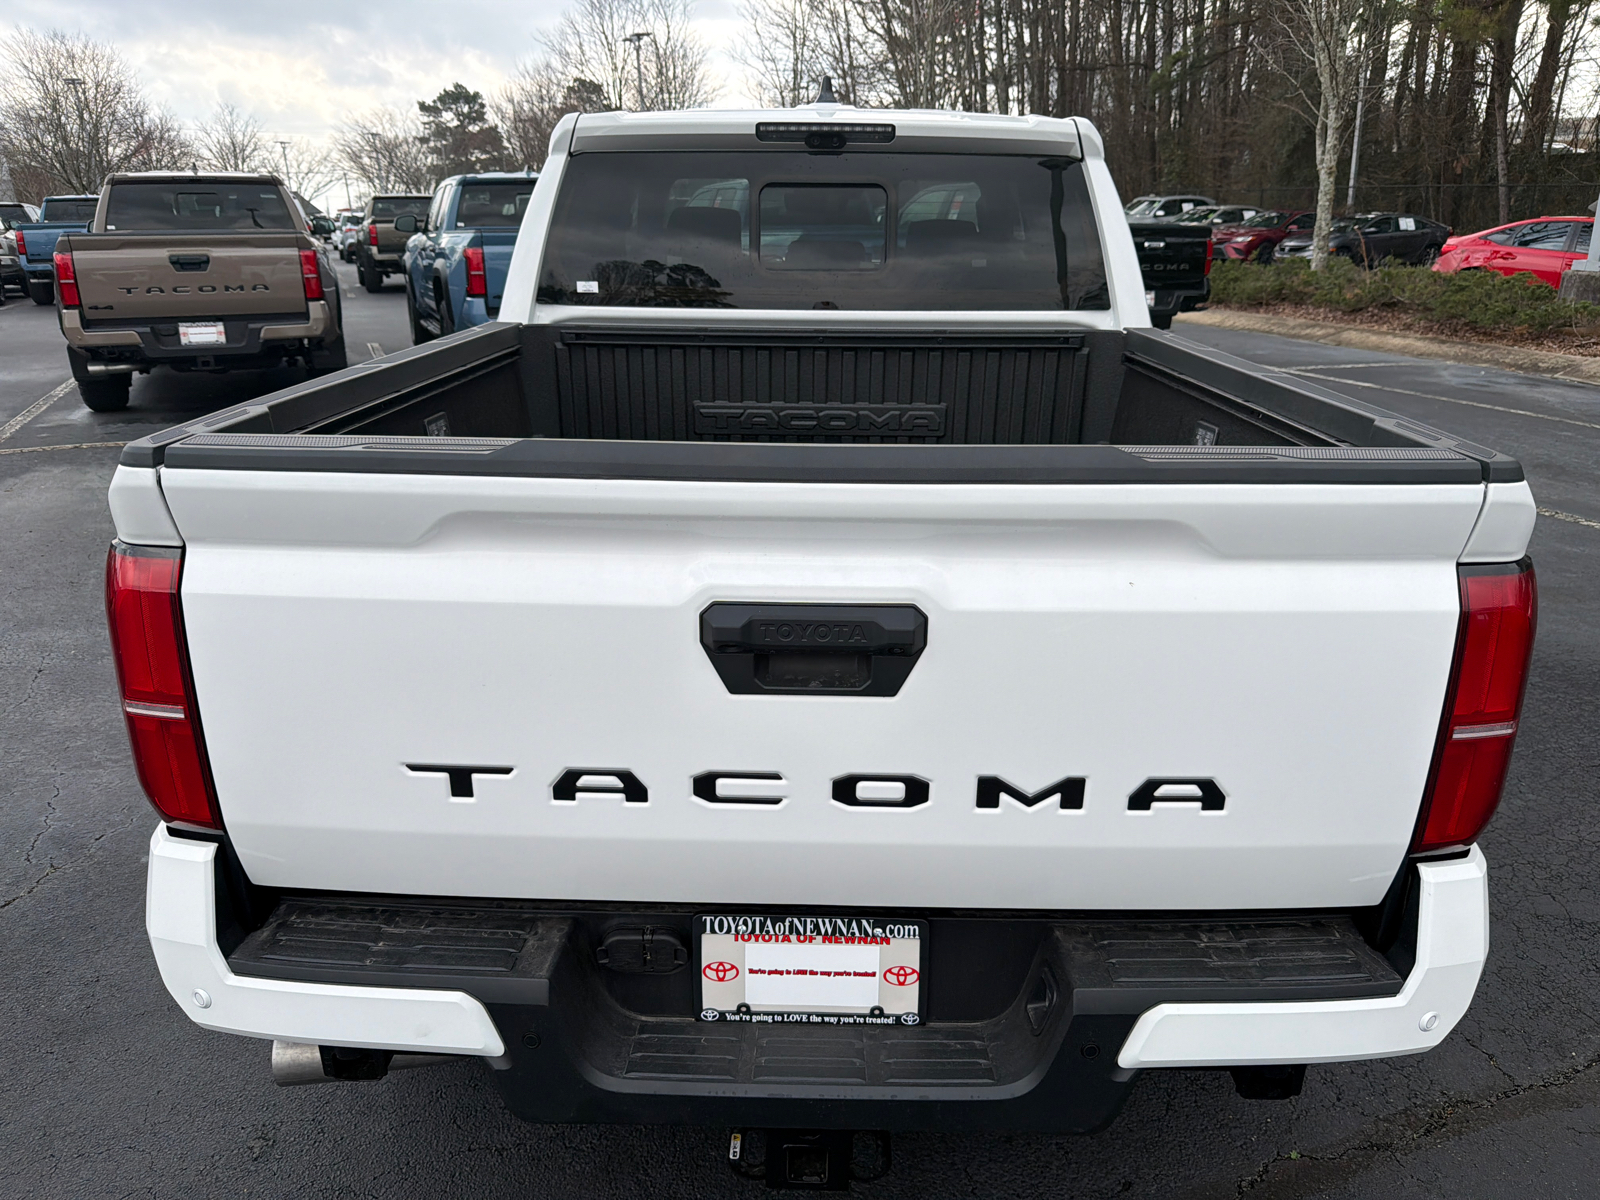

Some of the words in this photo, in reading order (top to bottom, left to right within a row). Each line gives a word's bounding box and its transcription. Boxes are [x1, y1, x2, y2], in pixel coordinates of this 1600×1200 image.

[1141, 263, 1190, 271] COMA
[118, 284, 270, 296] TACOMA
[699, 408, 940, 431] TACOMA
[760, 623, 867, 643] TOYOTA
[404, 763, 1227, 812] TACOMA
[734, 933, 792, 943] TOYOTA
[796, 935, 817, 944] OF
[822, 936, 890, 946] NEWNAN
[725, 1013, 750, 1021] You're
[752, 1014, 773, 1023] going
[774, 1014, 782, 1022] to
[784, 1014, 808, 1022] LOVE
[810, 1015, 822, 1023] the
[823, 1016, 838, 1024] way
[840, 1016, 864, 1025] you're
